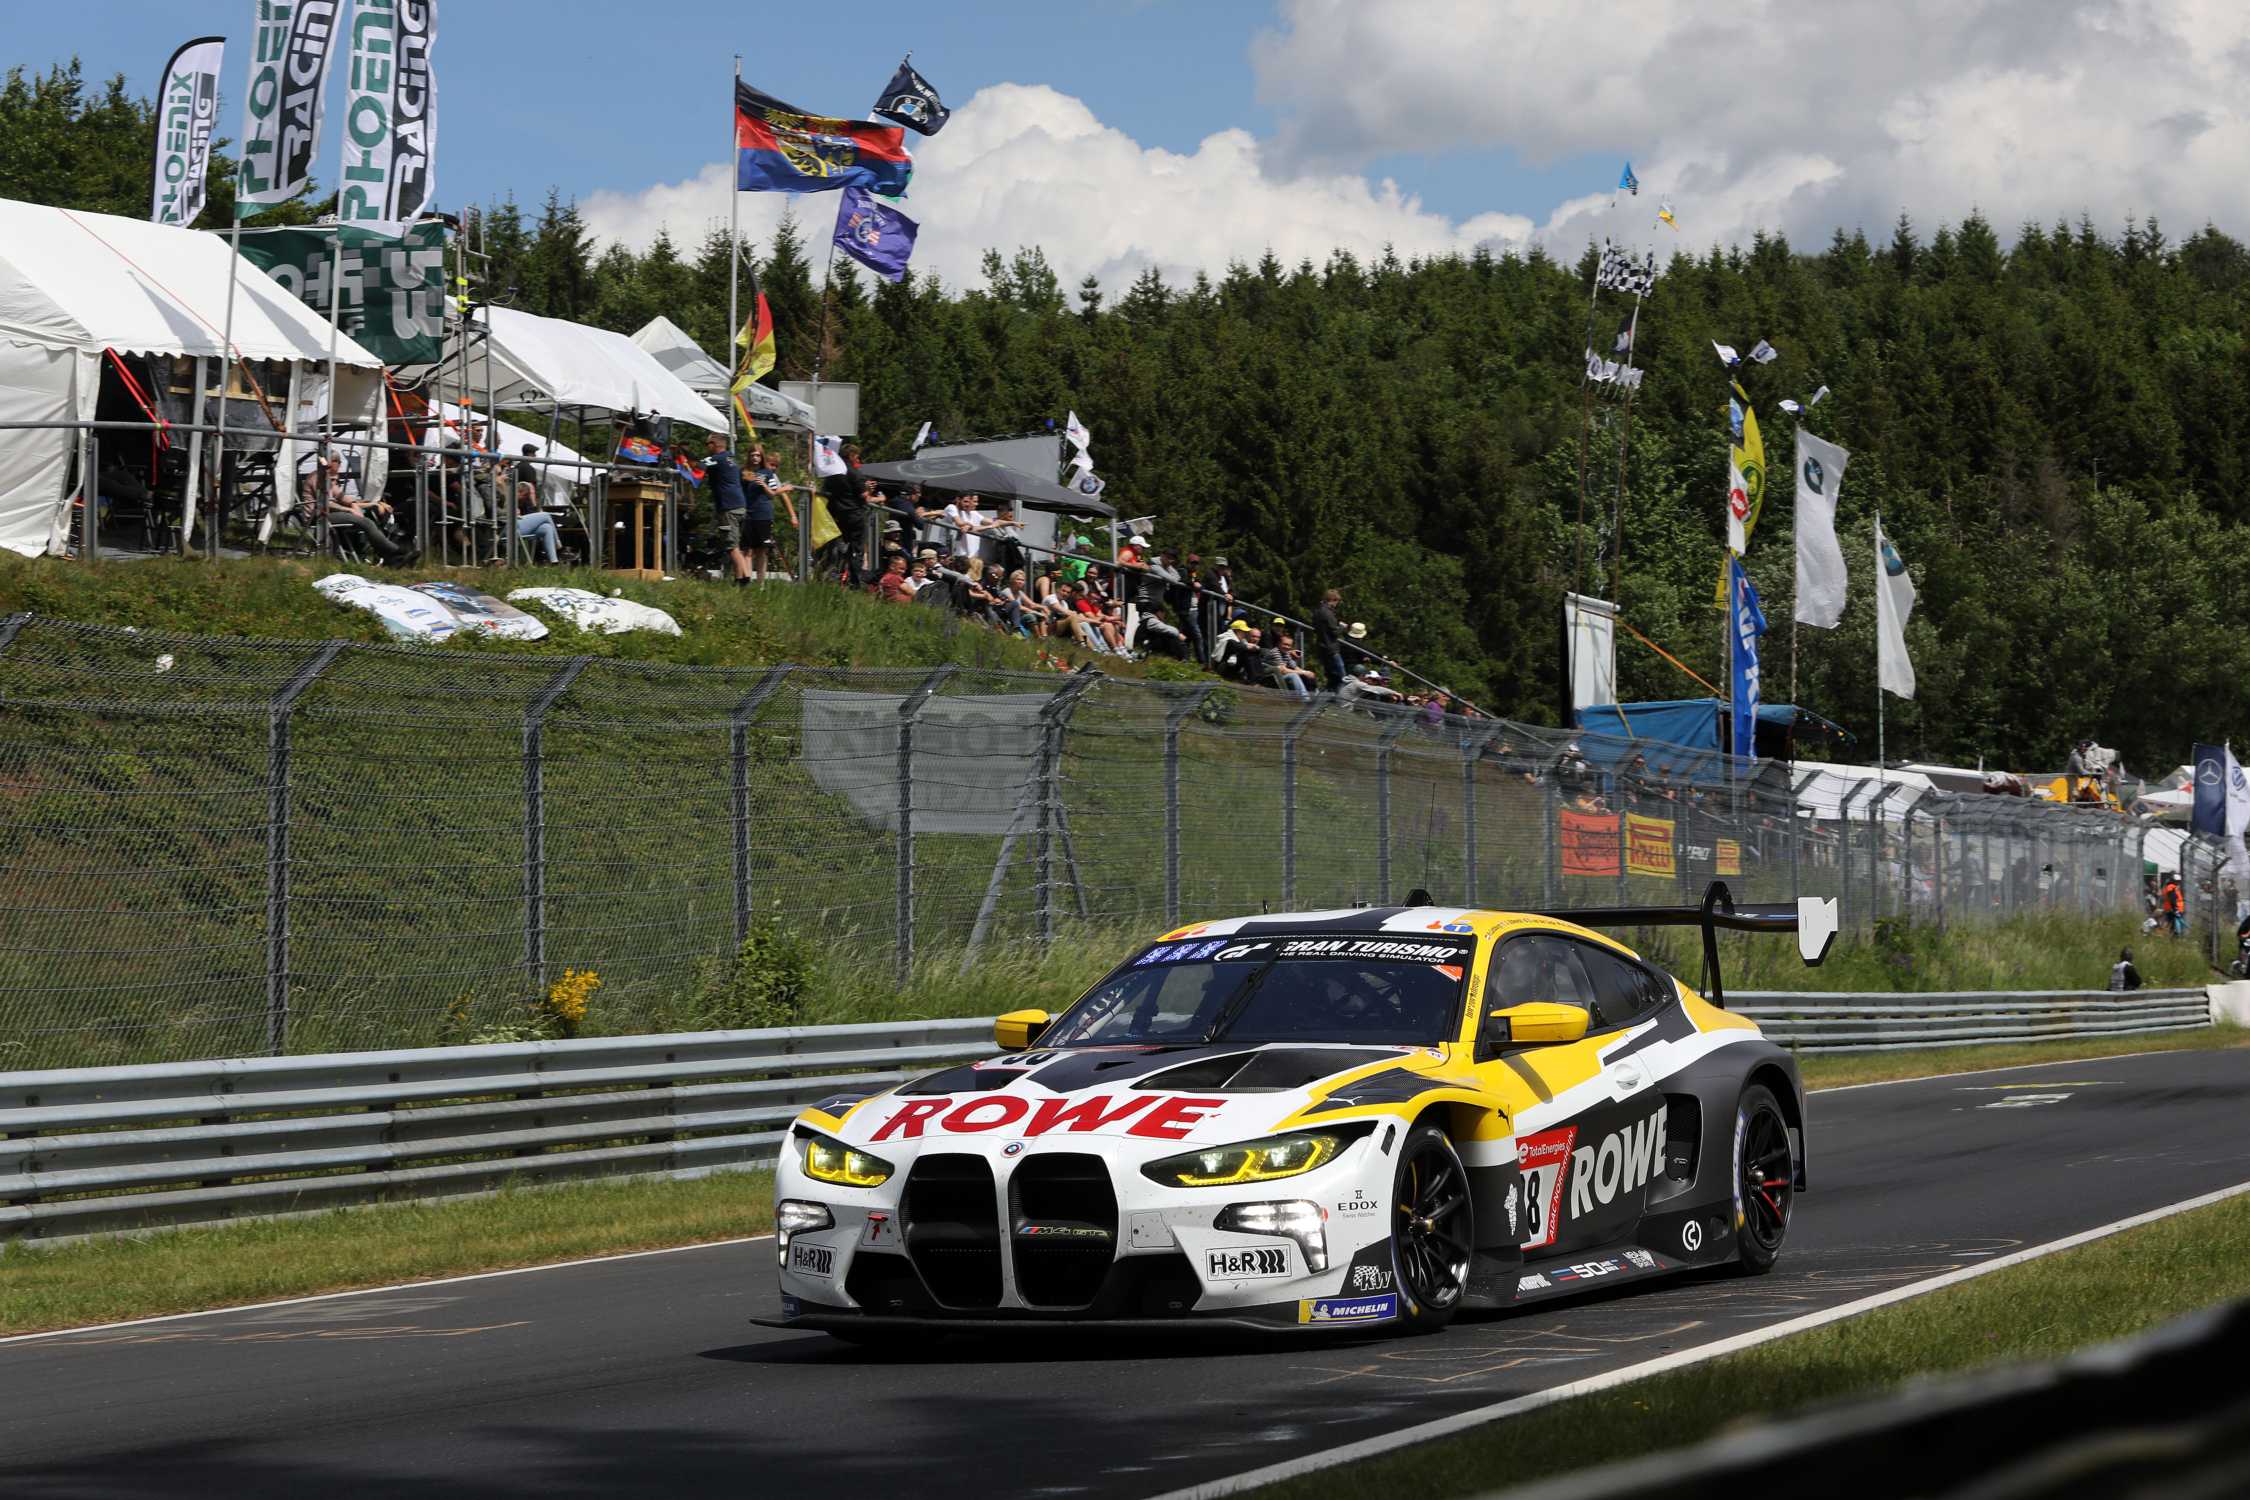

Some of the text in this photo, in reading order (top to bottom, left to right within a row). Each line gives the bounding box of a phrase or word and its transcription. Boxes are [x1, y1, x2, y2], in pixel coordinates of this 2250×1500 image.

[343, 0, 395, 221] PHOEN
[1329, 950, 1376, 958] DRIVING
[1377, 952, 1446, 964] SIMULATOR
[1348, 941, 1460, 959] TURISMO
[868, 1095, 1229, 1142] ROWE
[1529, 1140, 1566, 1157] TotalEnergies
[1570, 1103, 1668, 1220] ROWE
[1338, 1200, 1378, 1212] EDOX
[1520, 1170, 1541, 1236] 8
[794, 1246, 816, 1269] H&R
[1210, 1252, 1257, 1274] H&R
[1360, 1270, 1392, 1291] KW
[1569, 1261, 1609, 1279] 50
[1332, 1302, 1389, 1316] MICHELIN
